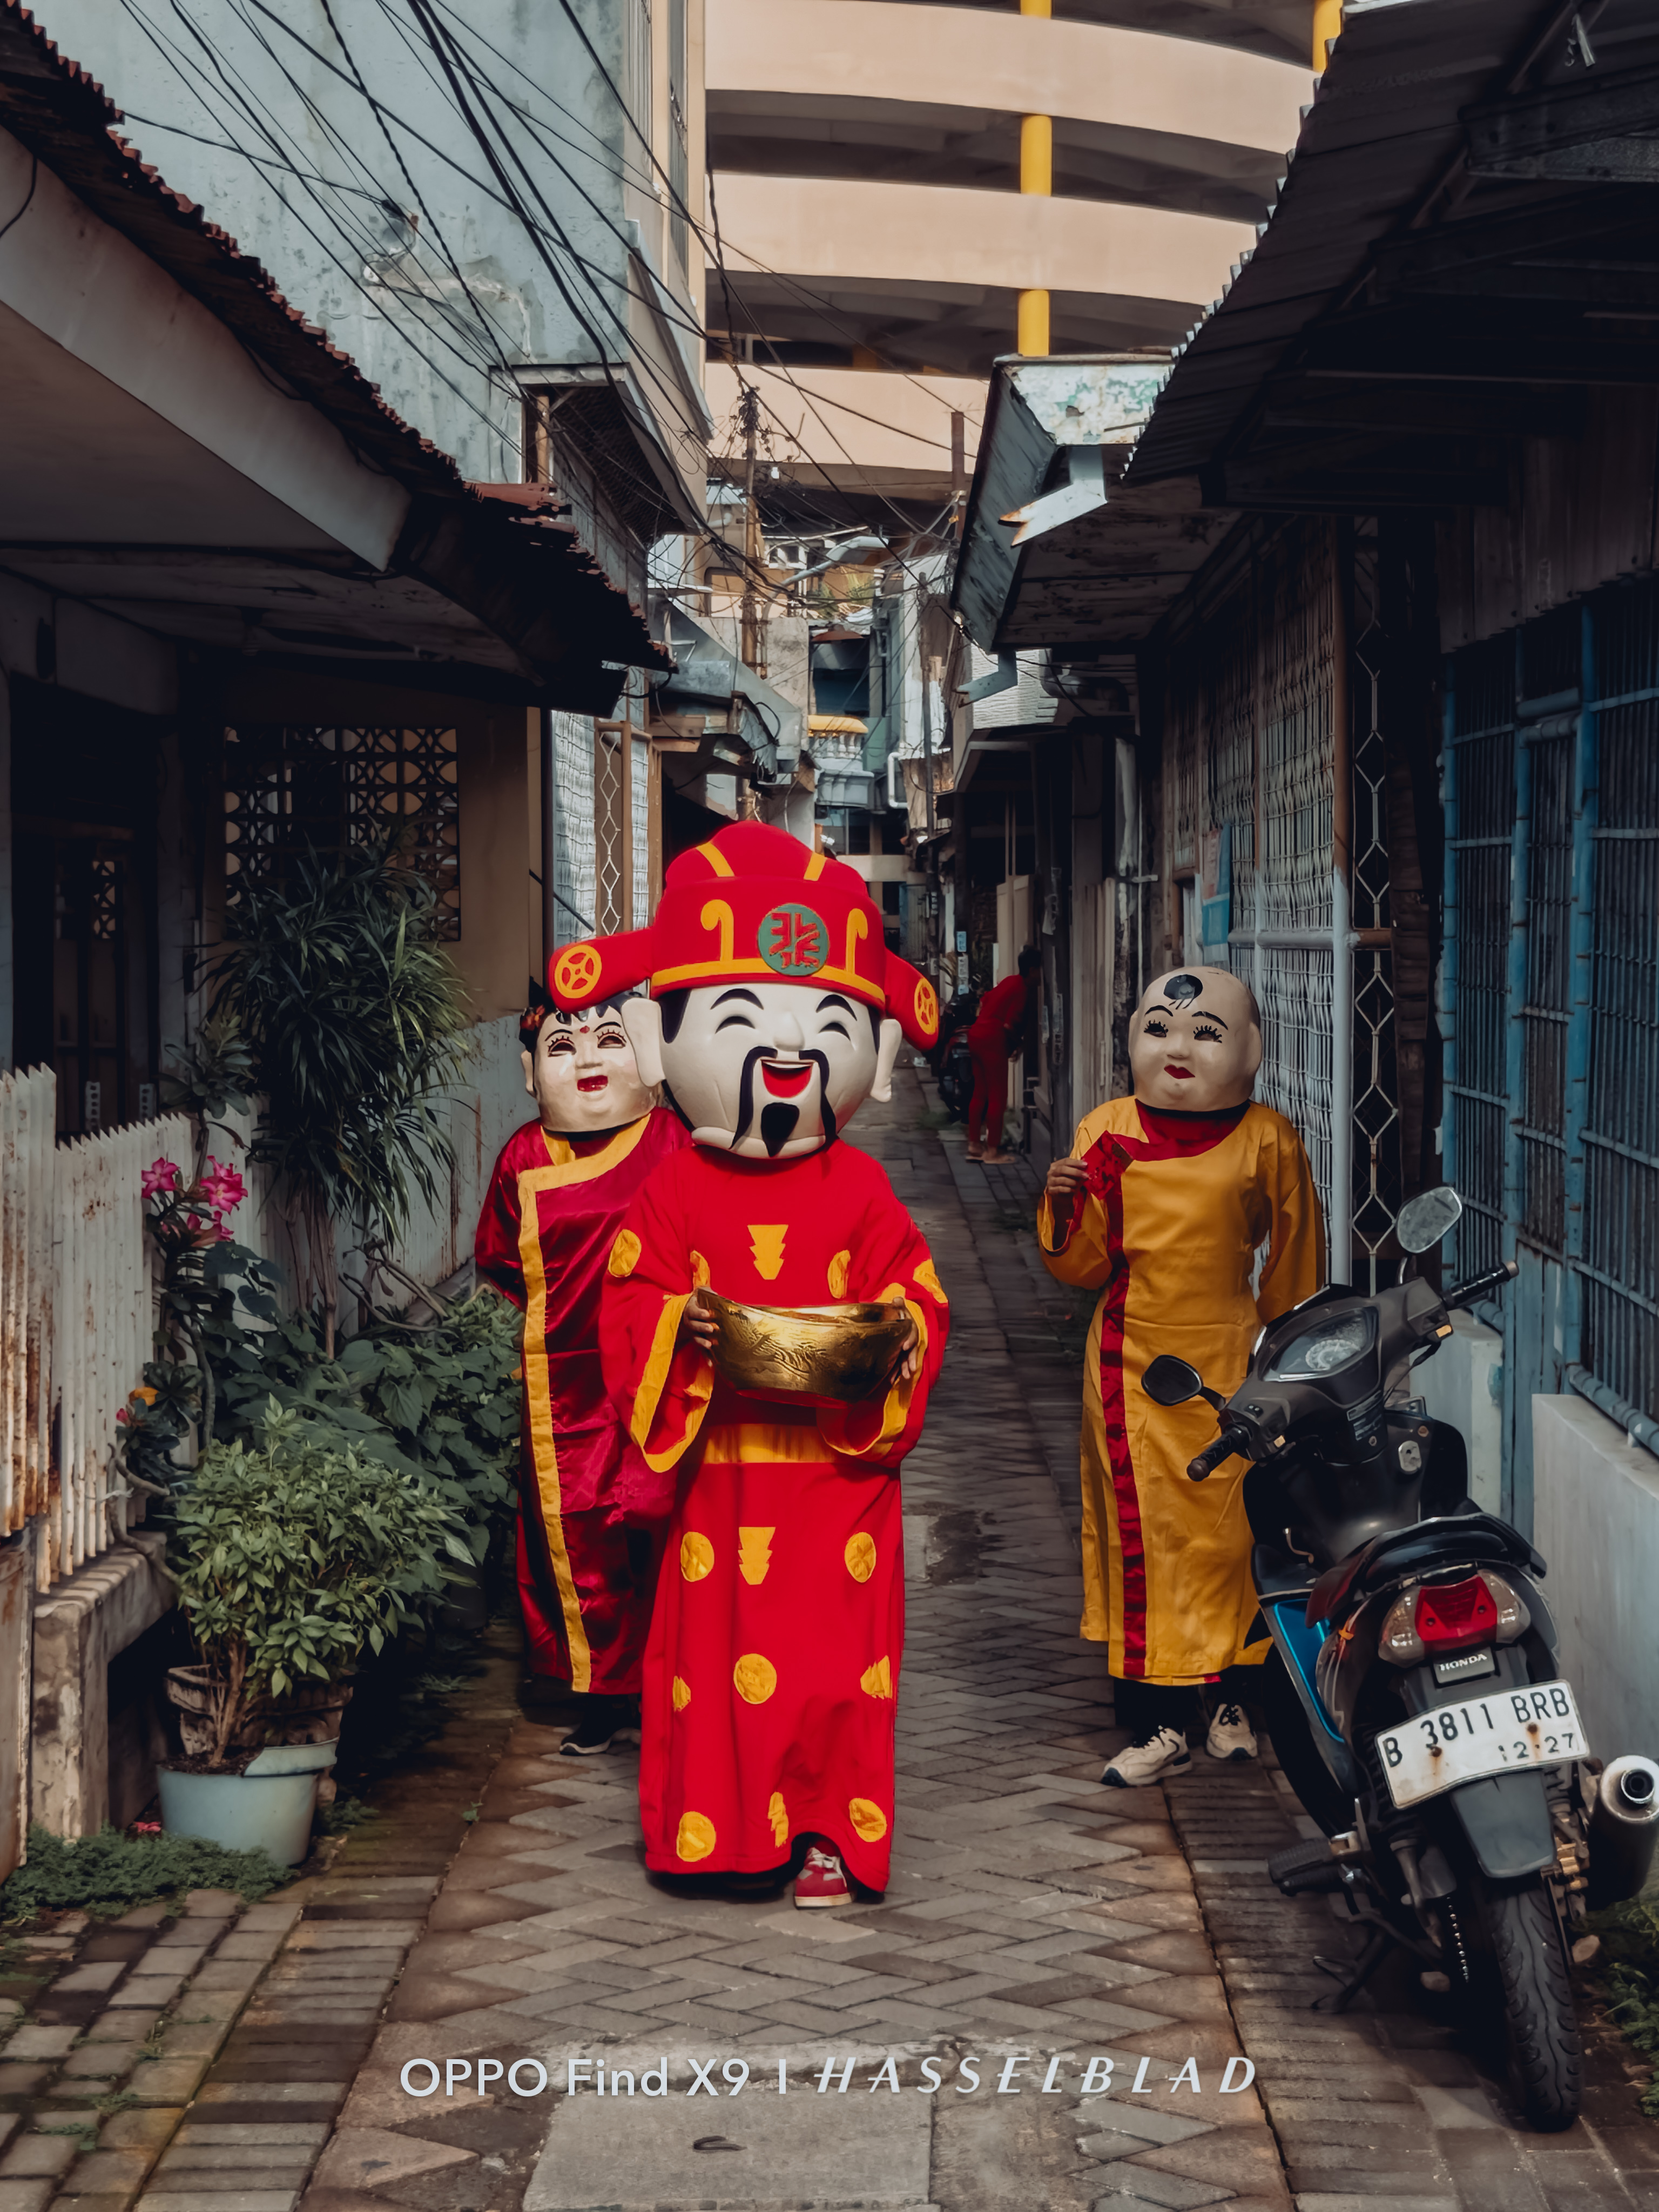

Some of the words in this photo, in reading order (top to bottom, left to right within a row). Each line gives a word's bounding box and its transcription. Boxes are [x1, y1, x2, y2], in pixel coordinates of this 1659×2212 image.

[1439, 1653, 1488, 1671] HONDA
[1382, 1736, 1403, 1768] B
[1420, 1703, 1494, 1749] 3811
[1510, 1688, 1570, 1723] BRB
